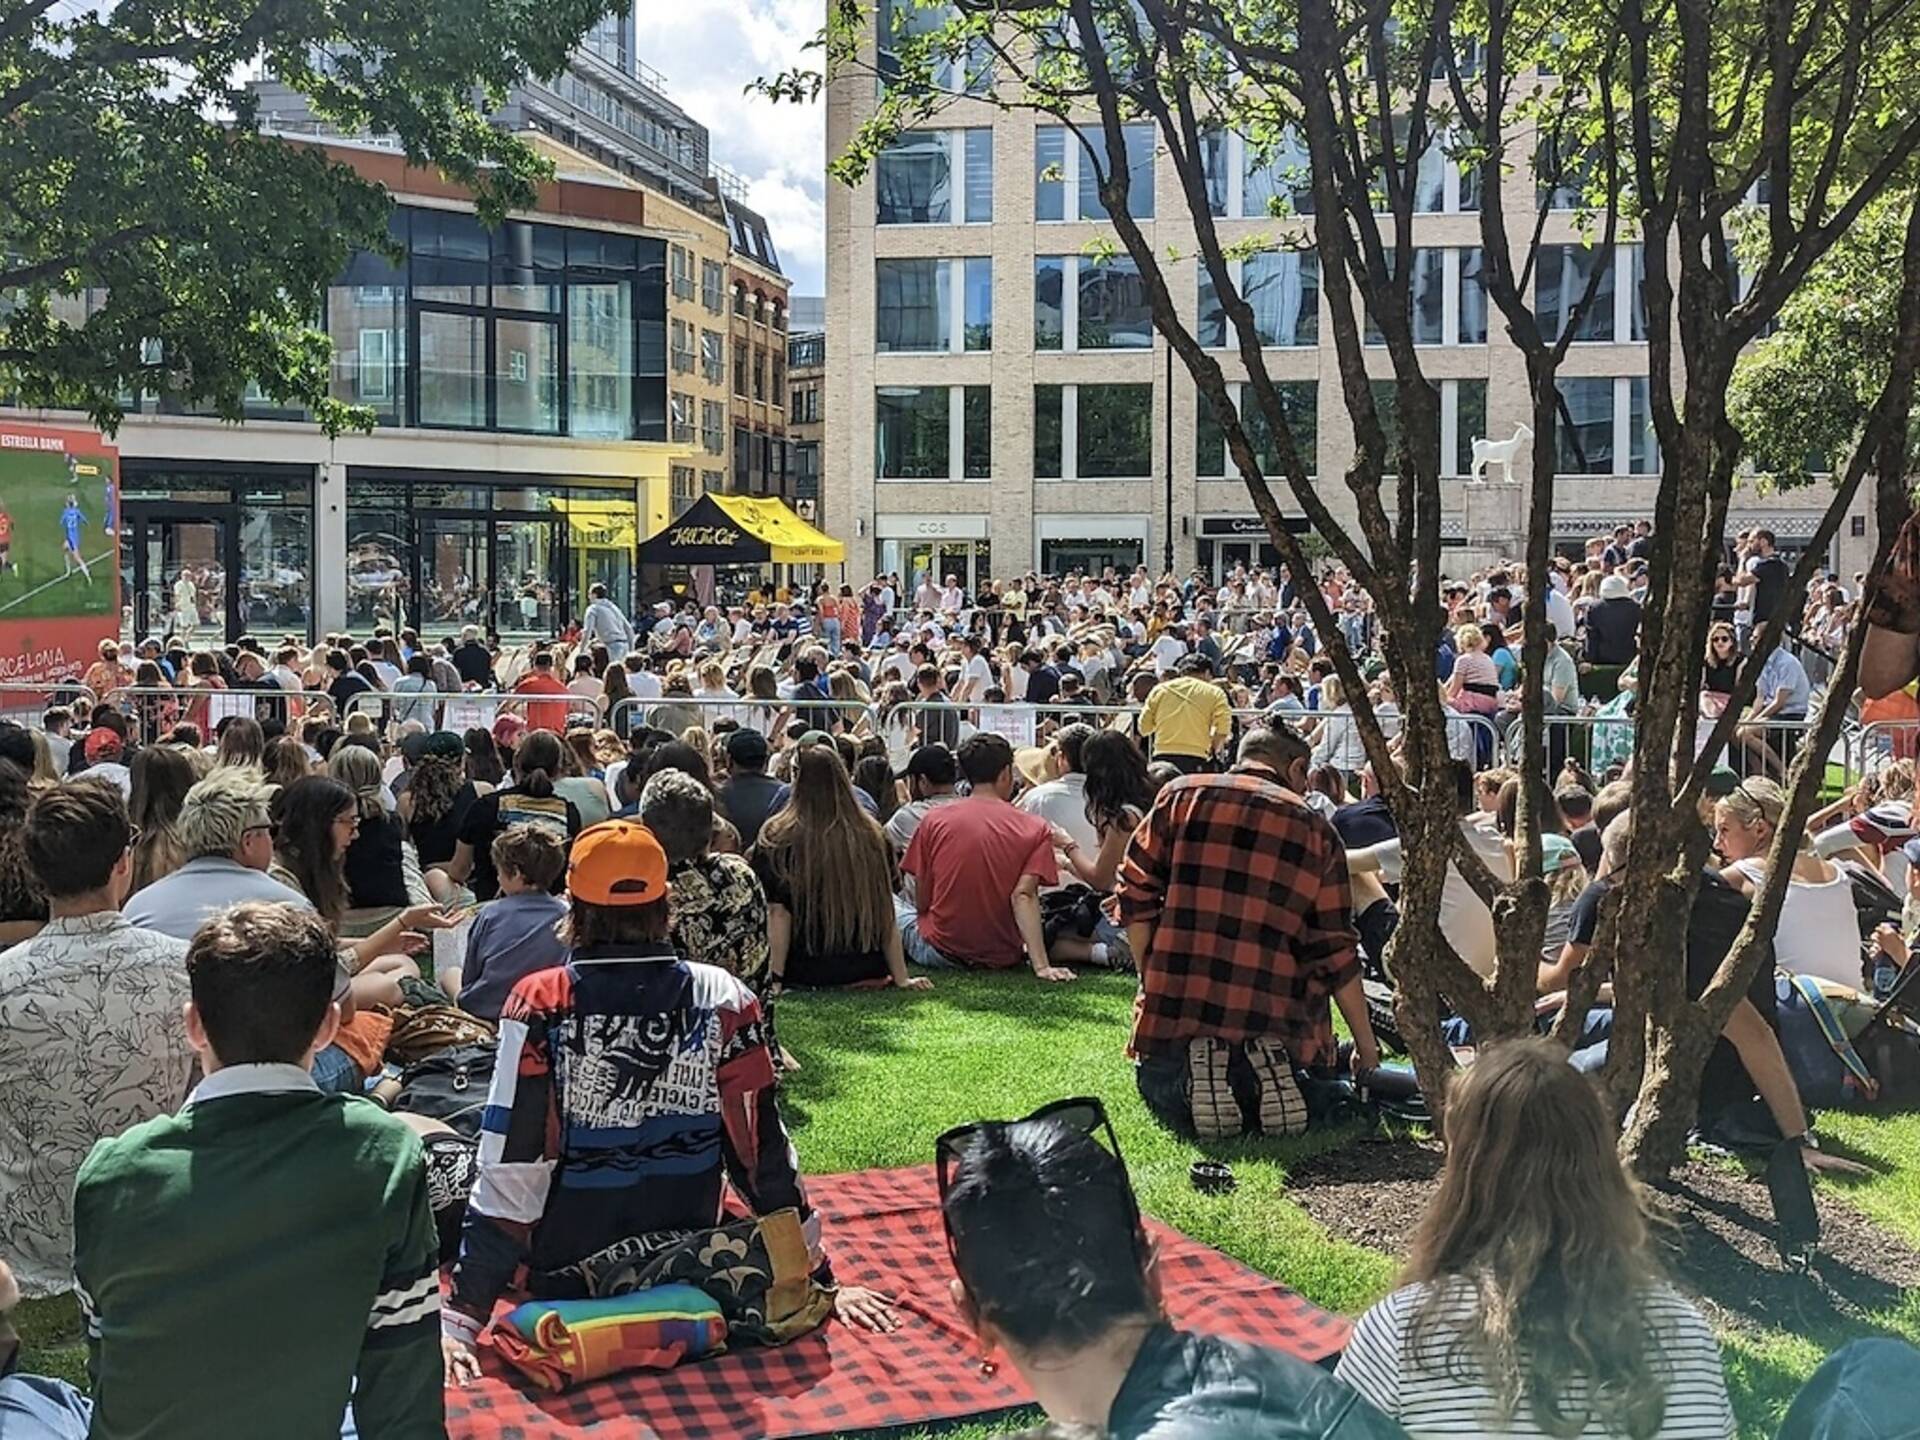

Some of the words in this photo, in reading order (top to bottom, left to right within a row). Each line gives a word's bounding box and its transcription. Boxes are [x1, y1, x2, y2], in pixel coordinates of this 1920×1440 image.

[1, 434, 38, 448] ESTRELLA
[40, 437, 64, 450] DAMM
[918, 522, 947, 533] COS
[670, 526, 697, 546] Kill
[715, 526, 739, 546] Cat
